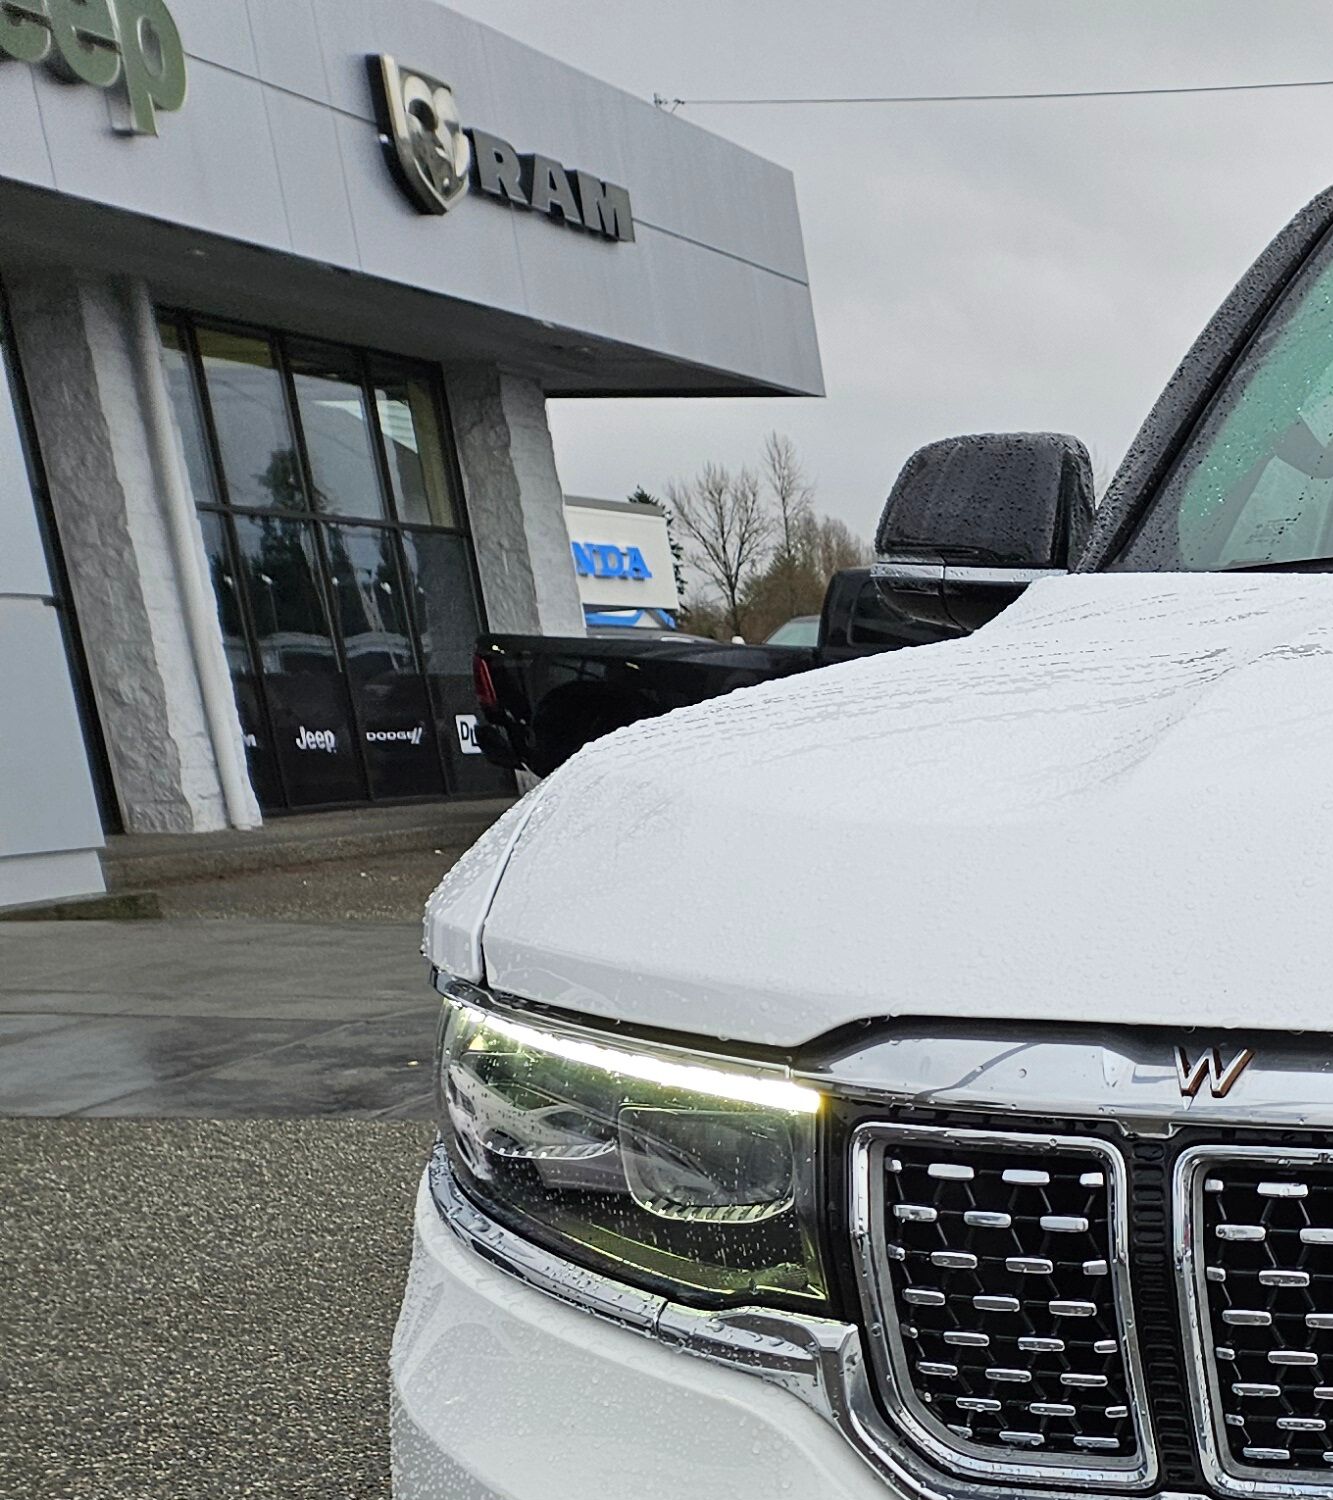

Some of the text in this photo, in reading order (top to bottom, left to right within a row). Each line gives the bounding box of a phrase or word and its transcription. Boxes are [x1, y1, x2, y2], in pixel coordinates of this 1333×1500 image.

[470, 127, 635, 243] RAM
[295, 726, 337, 753] Jeep
[366, 730, 416, 742] DODGE
